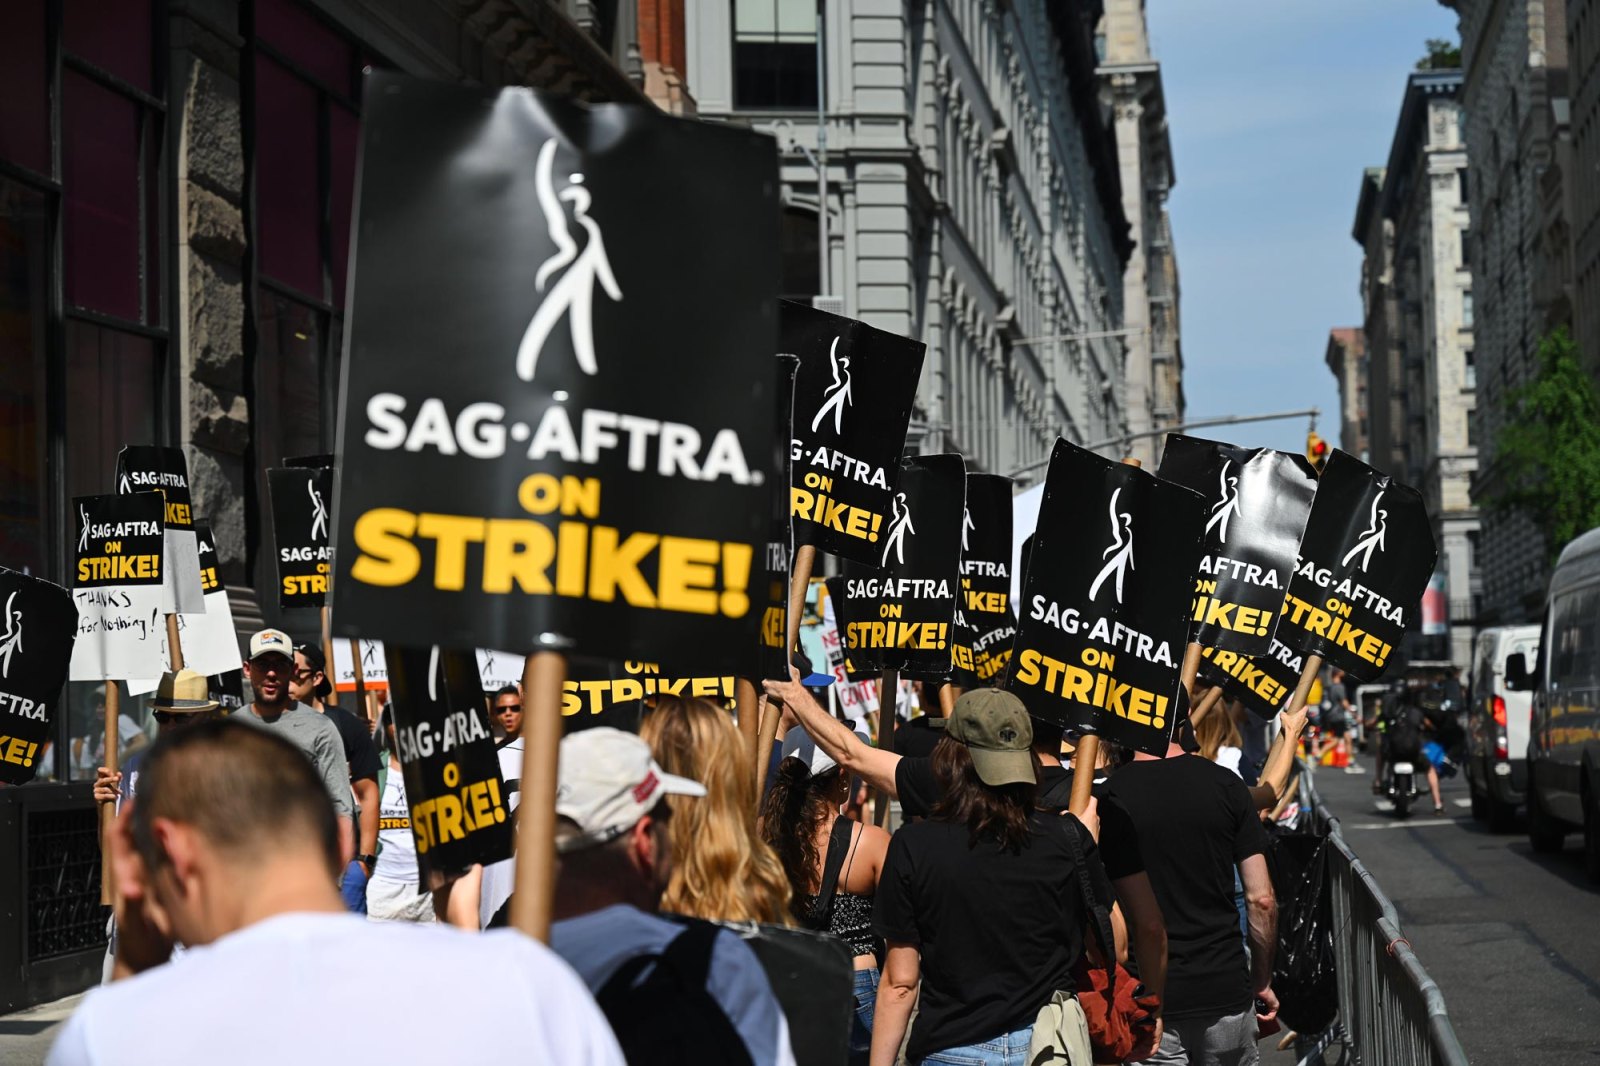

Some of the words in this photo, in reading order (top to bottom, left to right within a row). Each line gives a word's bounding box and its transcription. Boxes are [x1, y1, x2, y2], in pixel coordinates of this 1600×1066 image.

[804, 472, 833, 493] ON
[518, 473, 601, 519] ON
[791, 487, 883, 543] RIKE!
[105, 541, 121, 553] ON
[78, 555, 159, 582] STRIKE!
[351, 507, 754, 619] STRIKE!
[1199, 555, 1284, 590] AFTRA.
[77, 590, 132, 608] THANKS
[879, 603, 902, 618] ON
[1326, 598, 1353, 619] ON
[79, 616, 98, 634] for
[1192, 595, 1273, 637] IKE!
[846, 621, 948, 650] STRIKE!
[1081, 647, 1116, 671] ON
[1016, 649, 1169, 729] STRIKE!
[443, 762, 460, 788] O
